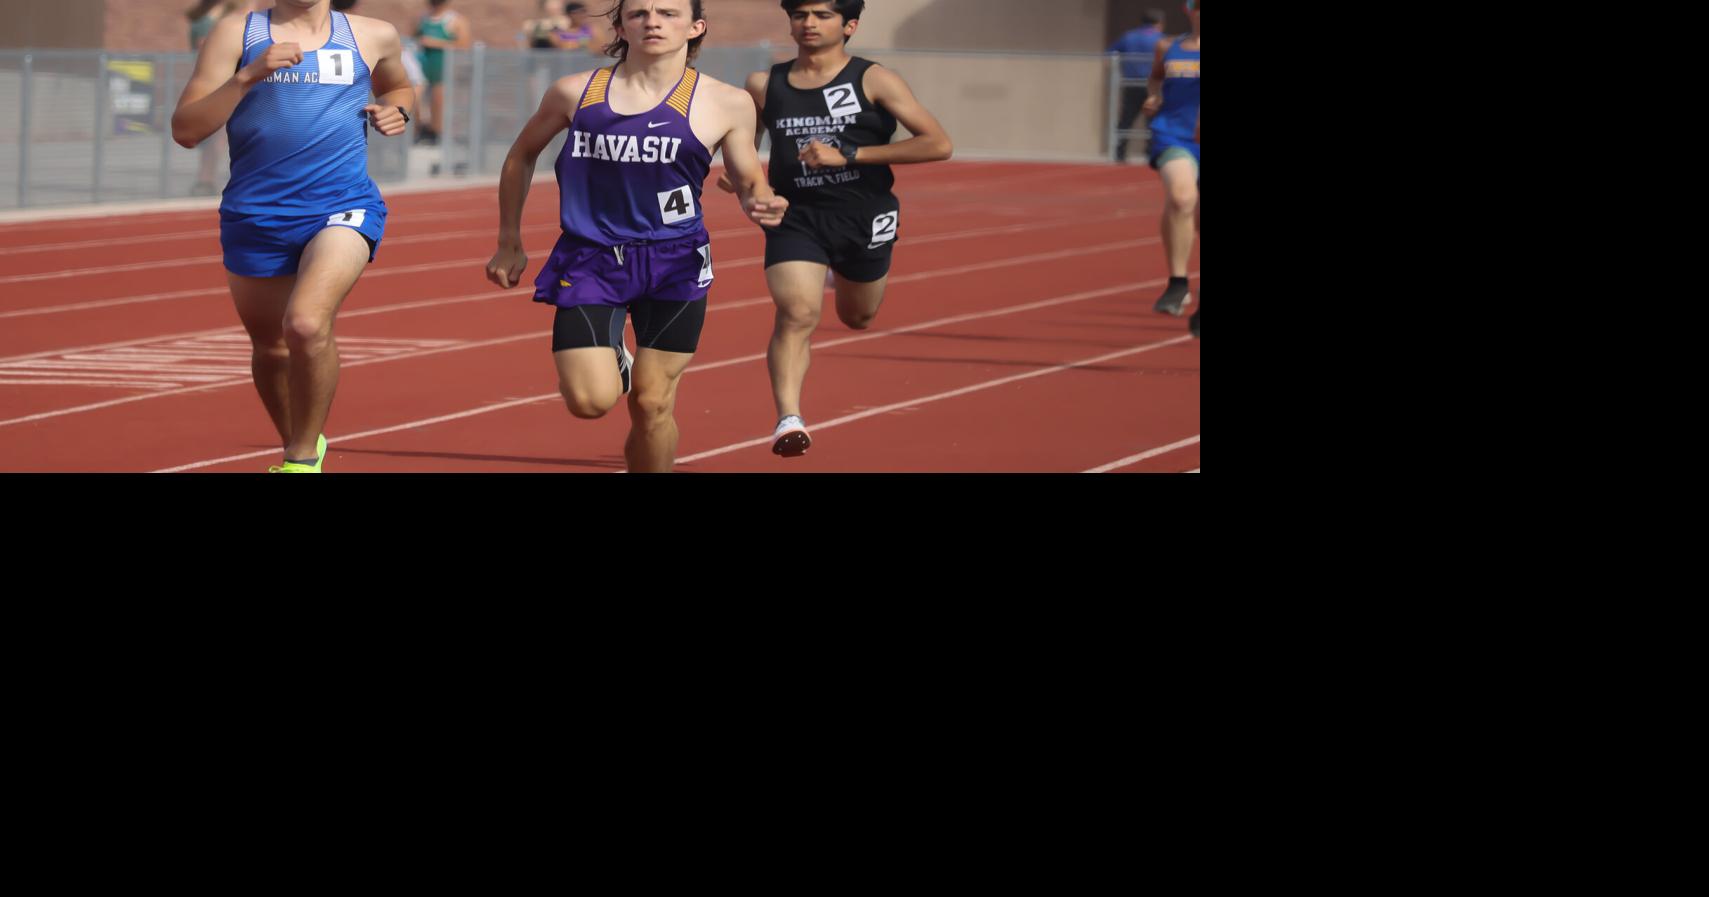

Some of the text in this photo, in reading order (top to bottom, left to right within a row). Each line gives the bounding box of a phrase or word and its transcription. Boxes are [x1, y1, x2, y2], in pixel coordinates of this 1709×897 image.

[330, 53, 343, 76] 1
[264, 71, 319, 83] GMAN AC
[827, 87, 856, 110] 2
[775, 114, 857, 129] KINGMAN
[785, 124, 846, 136] ACADEMY
[571, 130, 682, 164] HAVASU
[794, 176, 825, 188] TRACK
[835, 169, 861, 183] FIELD
[663, 188, 690, 216] 4
[874, 215, 895, 236] 2
